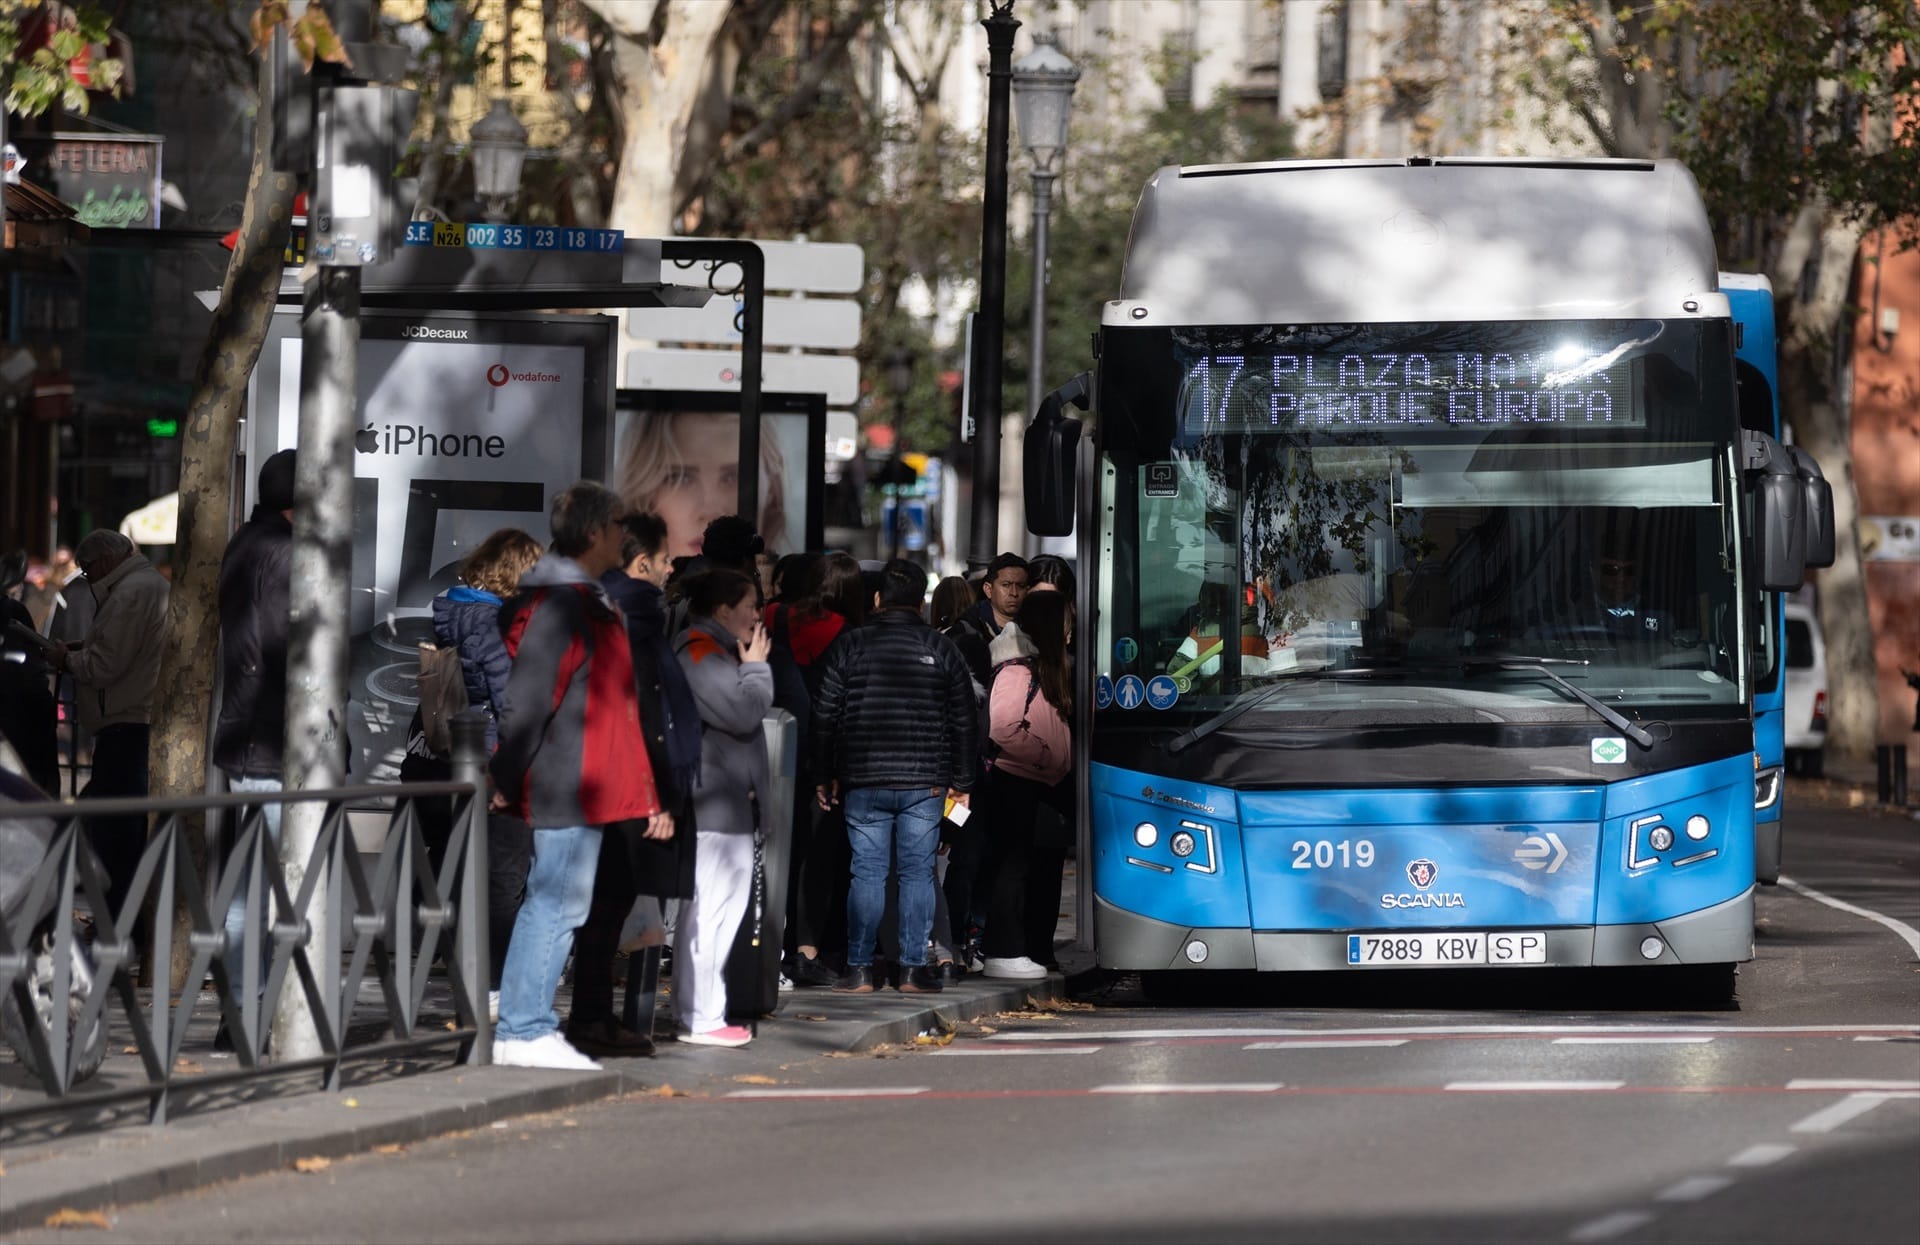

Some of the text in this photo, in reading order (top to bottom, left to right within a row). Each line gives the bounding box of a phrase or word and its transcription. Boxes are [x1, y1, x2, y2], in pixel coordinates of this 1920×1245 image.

[406, 225, 616, 249] S.E. N26 002 35 23 18 17
[402, 326, 468, 339] JCDecaux
[511, 372, 561, 383] vodafone
[1189, 356, 1245, 422] 17
[1273, 354, 1430, 386] PLAZA
[1271, 390, 1612, 424] PARQUE EUROPA
[385, 424, 505, 458] iPhone
[1291, 840, 1375, 869] 2019
[1381, 893, 1465, 909] SCANIA
[1366, 938, 1478, 960] 7889 KBV
